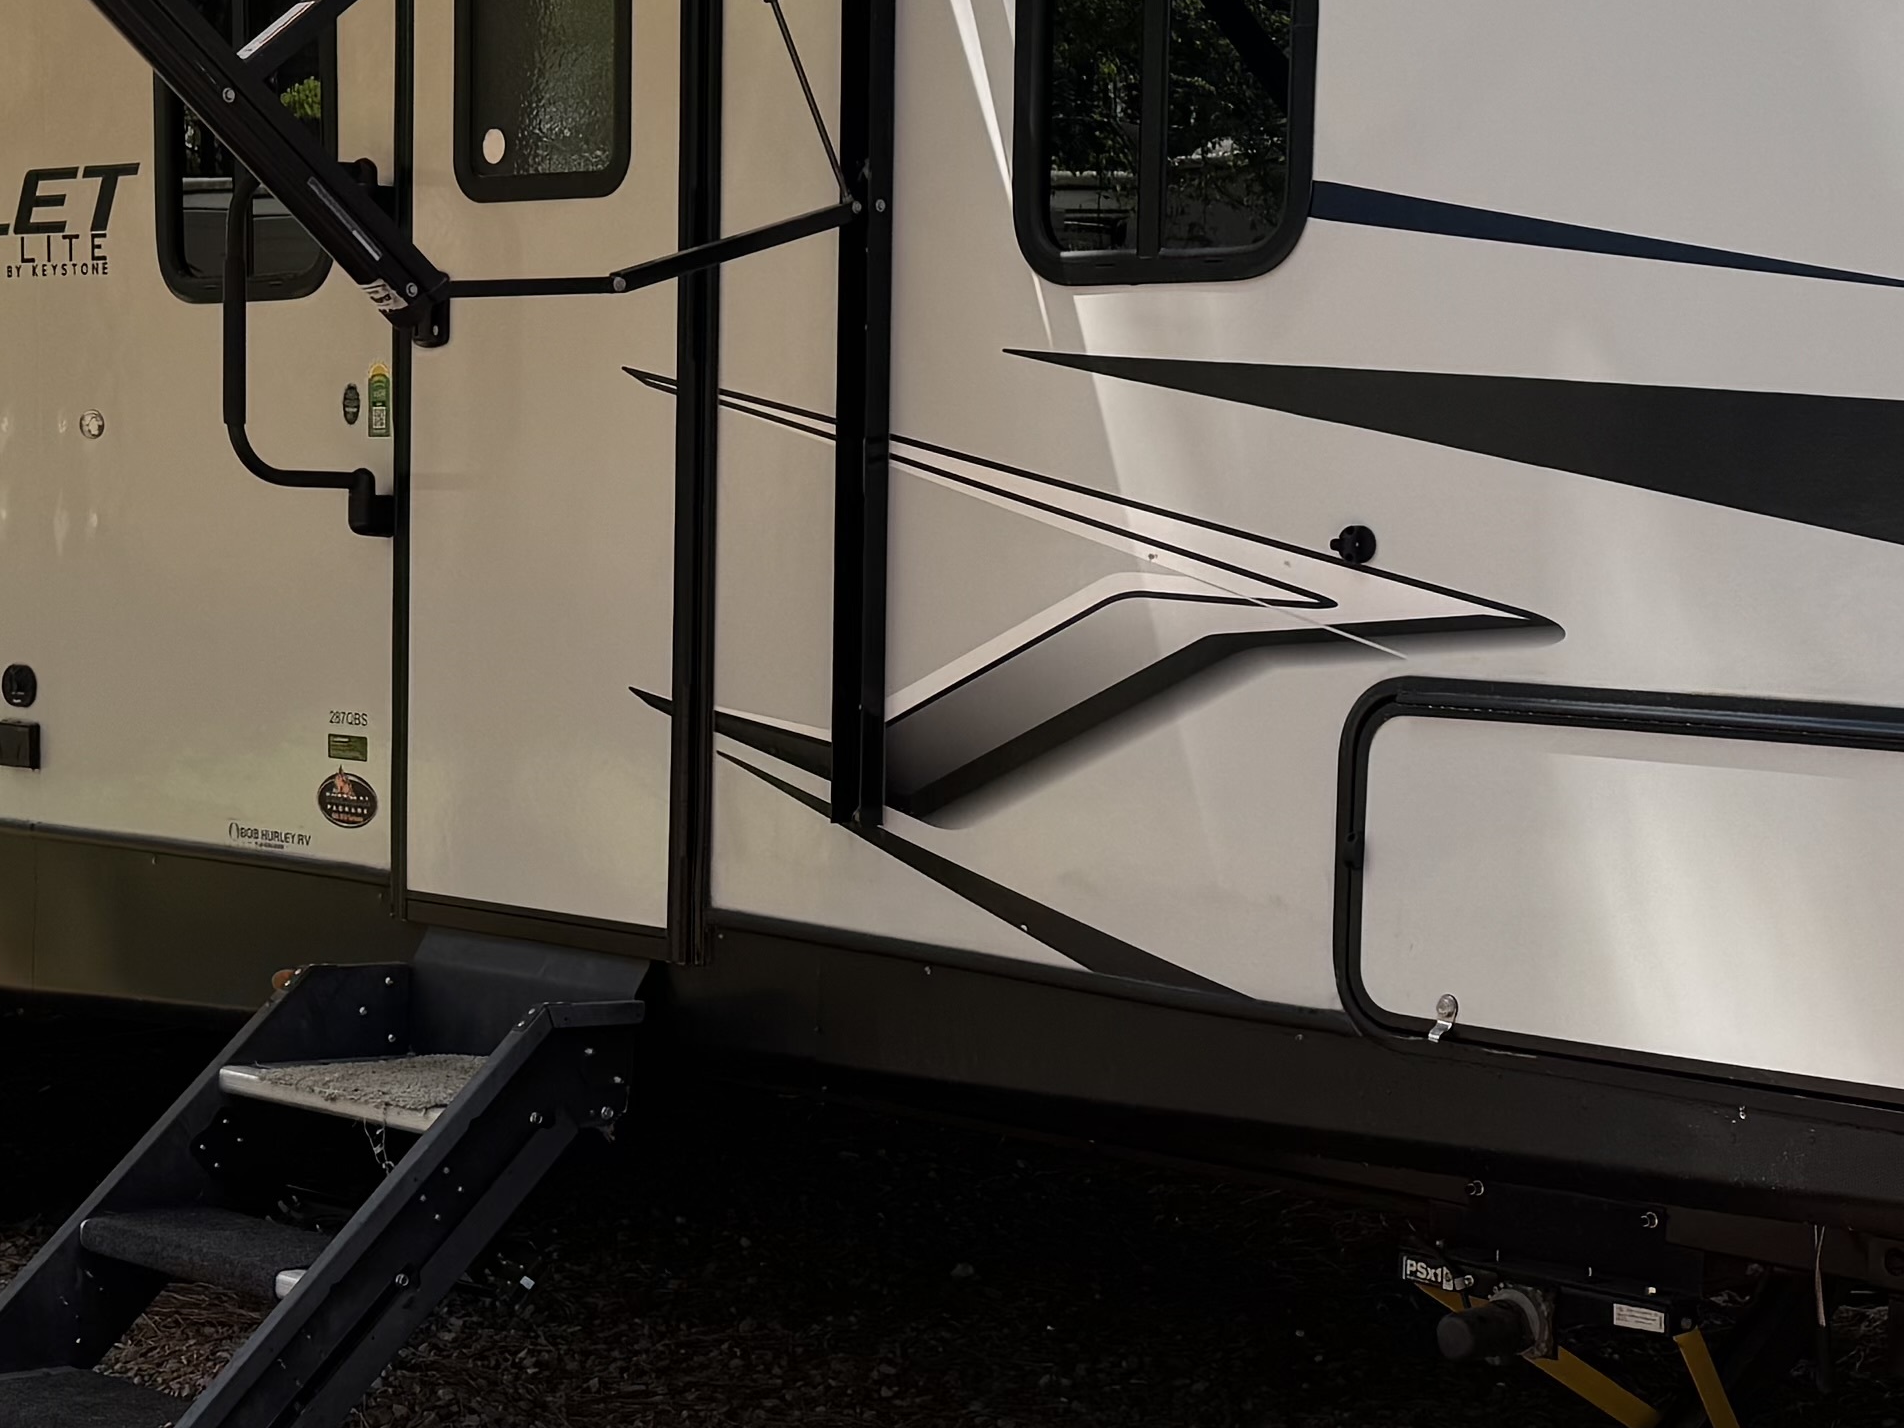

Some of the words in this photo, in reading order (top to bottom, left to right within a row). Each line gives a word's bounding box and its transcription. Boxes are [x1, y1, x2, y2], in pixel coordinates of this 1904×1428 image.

[20, 233, 107, 263] LITE
[6, 265, 22, 278] BY
[32, 262, 109, 277] KEYSTONE
[329, 710, 368, 726] 287QBS
[240, 827, 259, 839] BOB
[261, 829, 296, 844] HURLEY
[297, 834, 311, 846] RV
